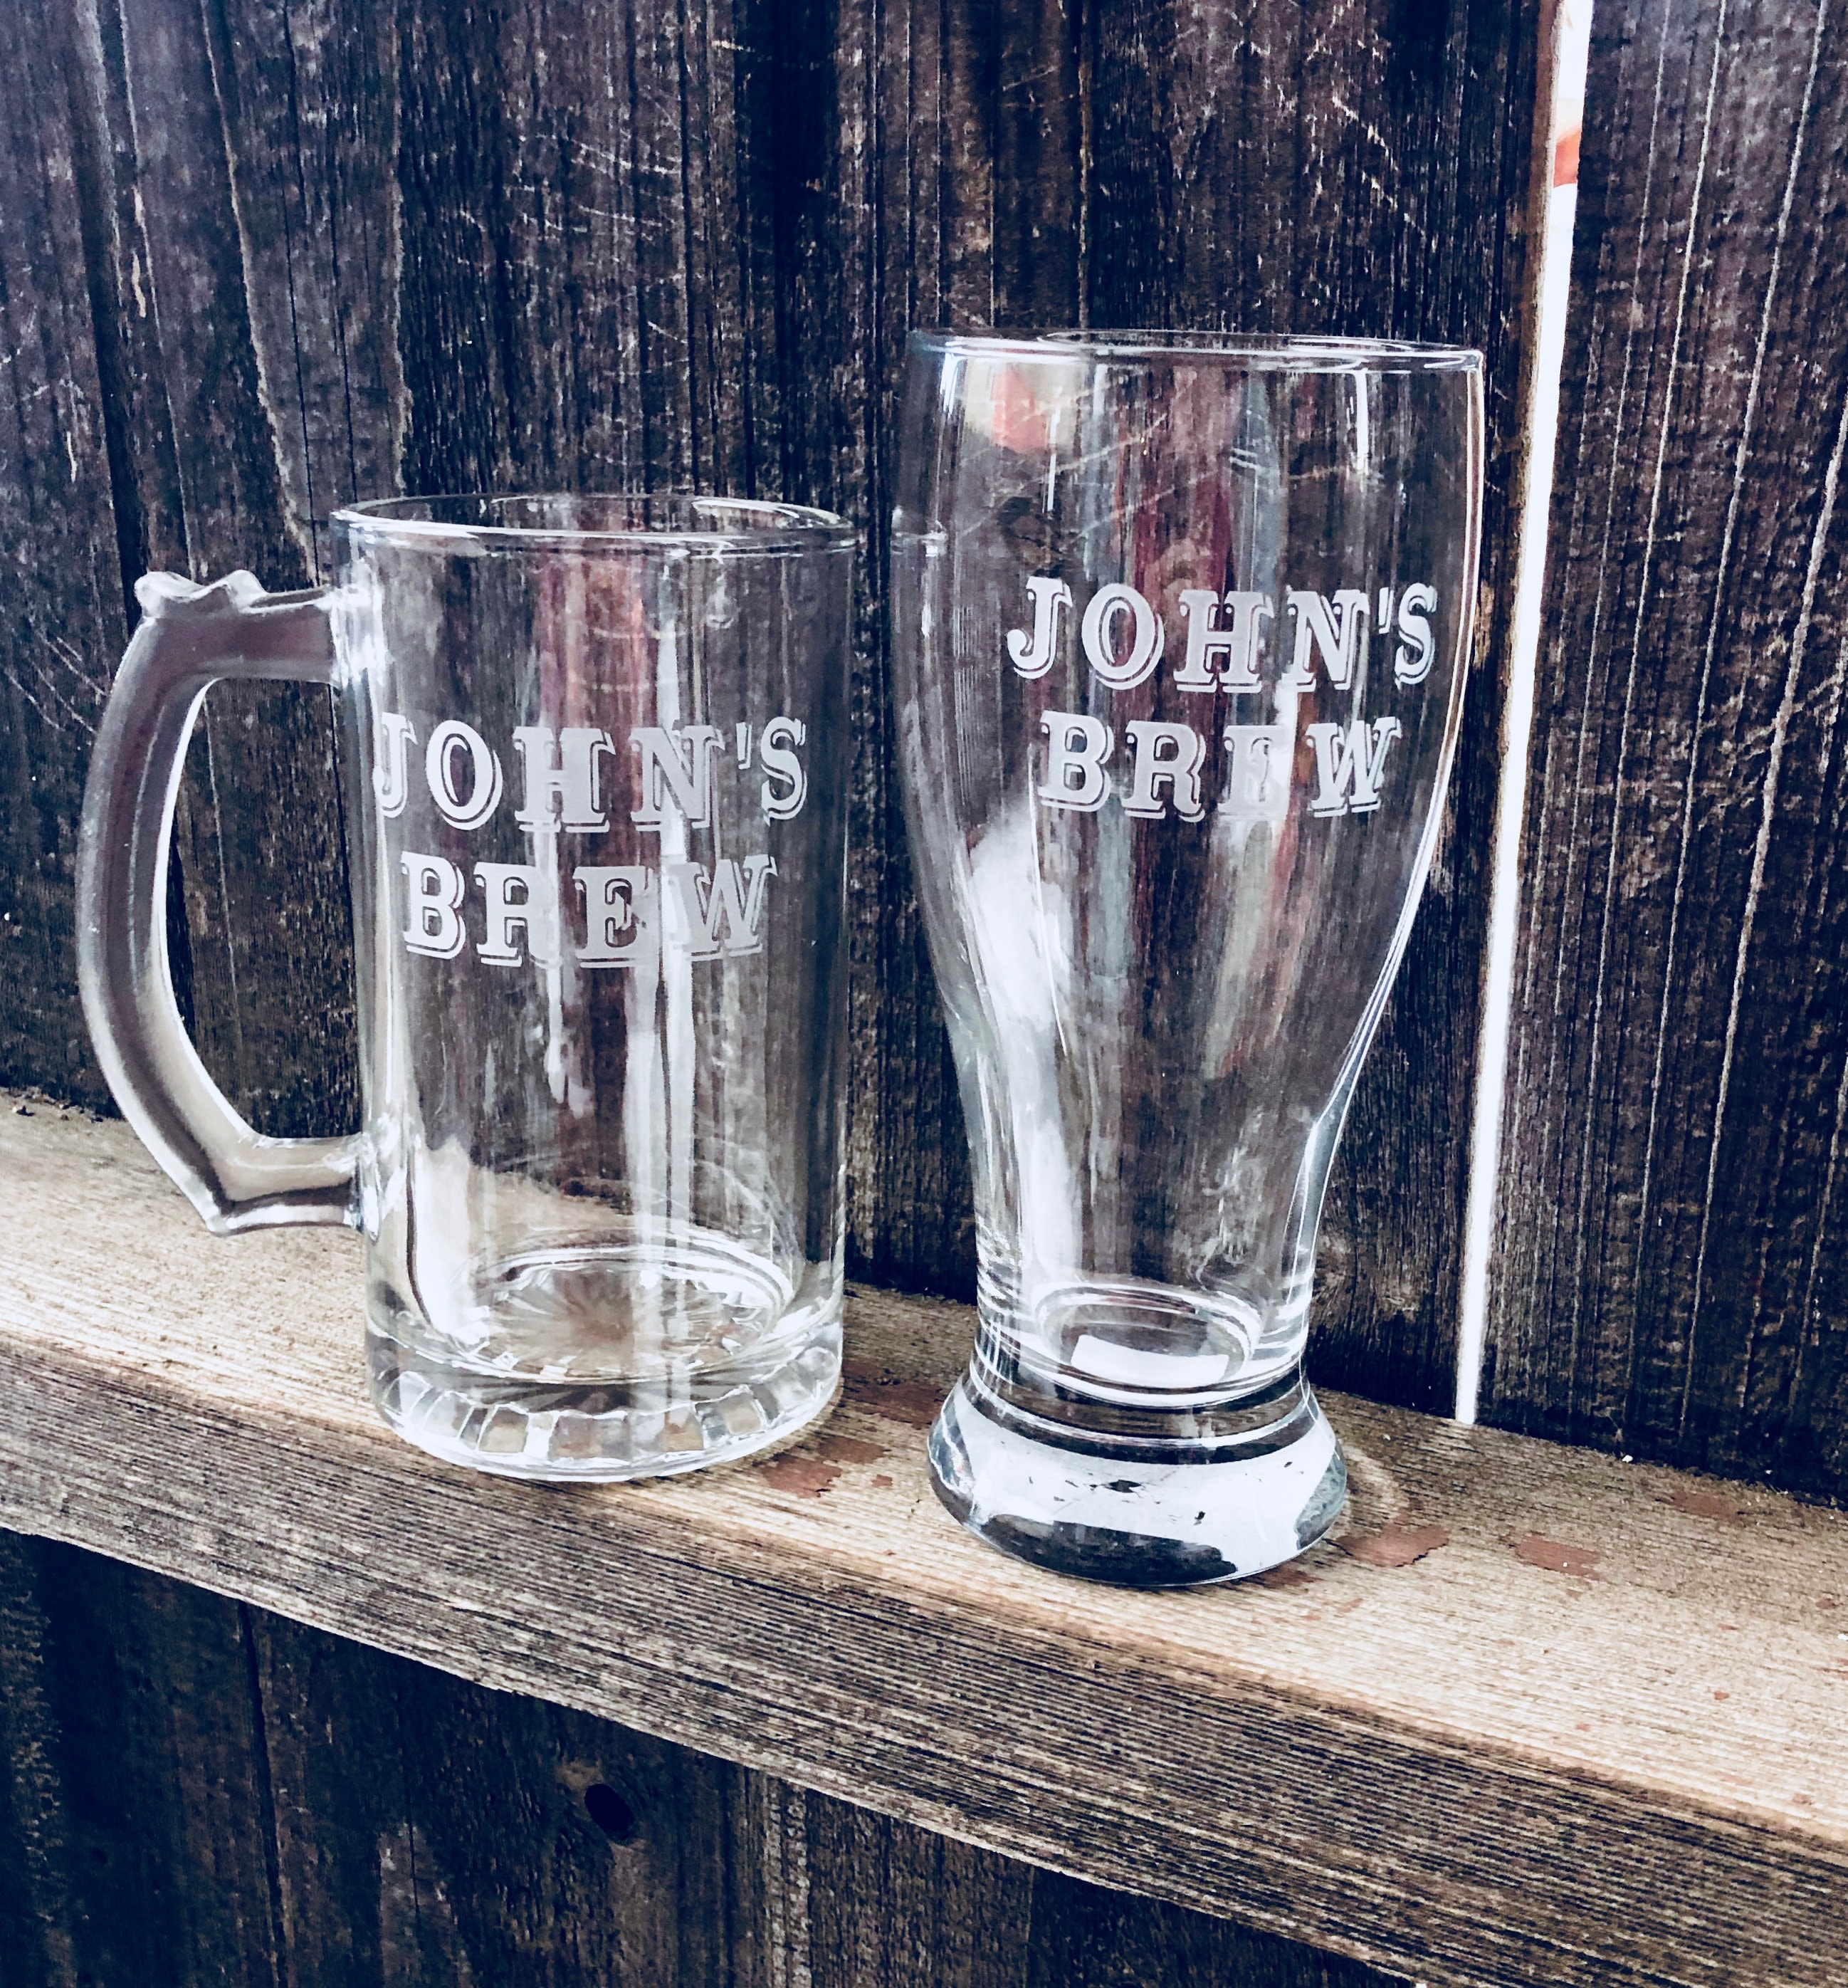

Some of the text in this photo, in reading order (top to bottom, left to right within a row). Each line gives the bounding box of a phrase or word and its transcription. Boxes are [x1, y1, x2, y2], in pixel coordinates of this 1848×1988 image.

[1007, 576, 1437, 693] JOHN'S
[373, 712, 807, 833] JOHN'S
[1038, 710, 1402, 822] BREW
[401, 850, 778, 969] BREW
